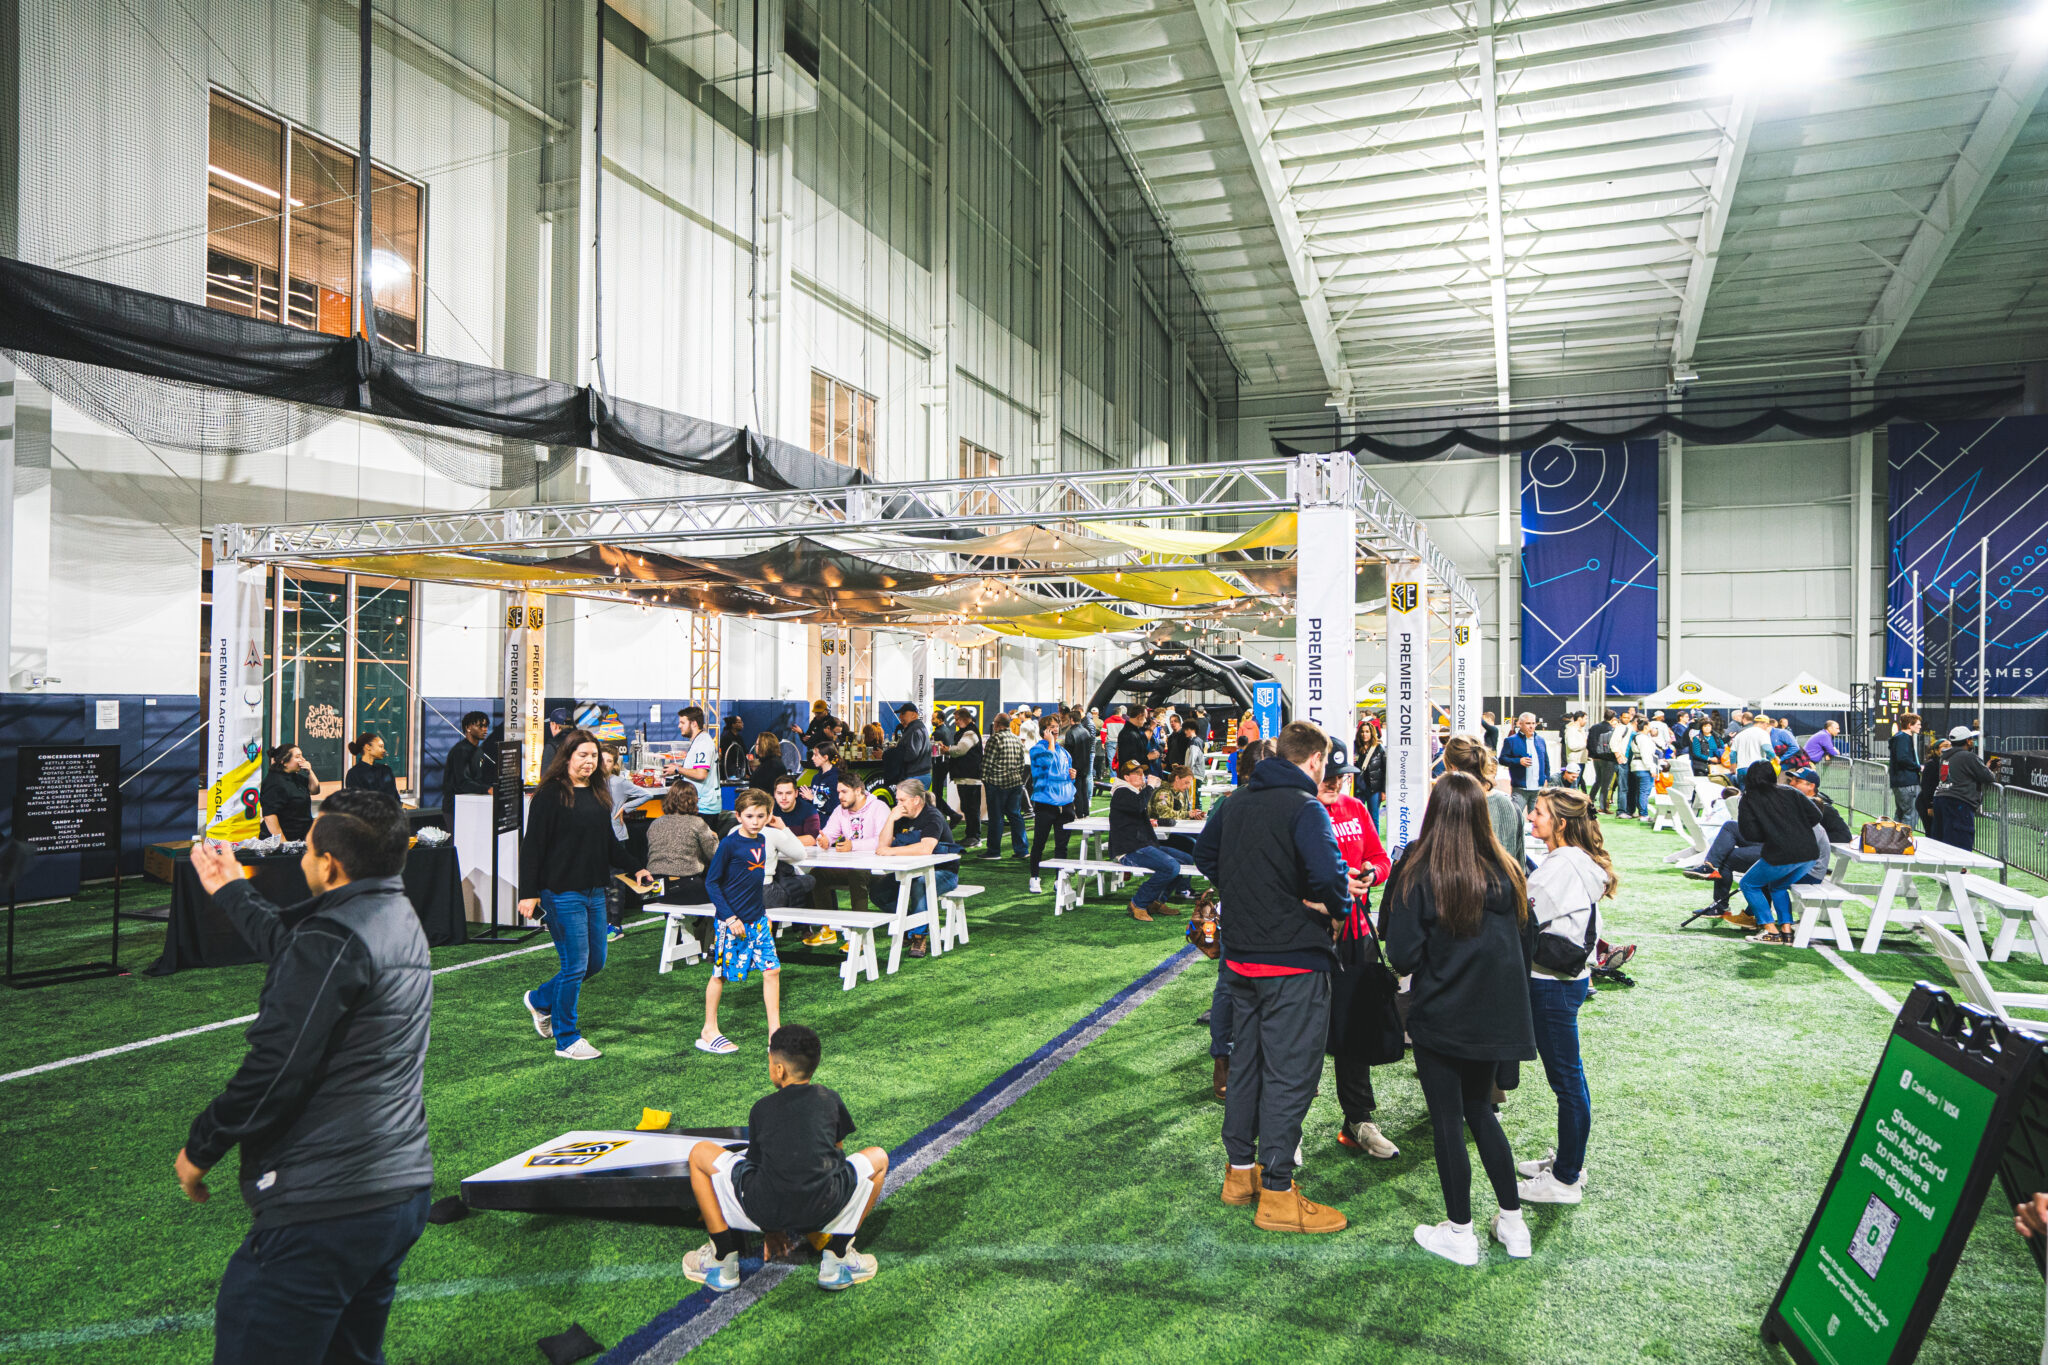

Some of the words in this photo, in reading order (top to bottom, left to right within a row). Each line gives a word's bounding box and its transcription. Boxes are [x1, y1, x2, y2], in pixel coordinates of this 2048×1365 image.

[219, 638, 227, 696] PREMIER
[510, 644, 519, 696] PREMIER
[532, 644, 540, 696] PREMIER
[1308, 618, 1322, 701] PREMIER
[1400, 633, 1411, 701] PREMIER
[1902, 668, 1937, 679] THE
[217, 699, 226, 768] LACROSSE
[510, 699, 518, 730] ZONE
[1400, 705, 1411, 746] ZONE
[694, 752, 706, 764] 12
[1399, 751, 1409, 792] Powered
[214, 771, 223, 822] LEAGUE
[1398, 792, 1408, 804] by
[1911, 1080, 1926, 1097] Cash
[1925, 1090, 1938, 1105] App
[1876, 1118, 1900, 1146] Cash
[1898, 1137, 1919, 1162] App
[1919, 1152, 1948, 1182] Card
[1891, 1108, 1918, 1137] Show
[1915, 1130, 1942, 1153] your
[1859, 1153, 1887, 1180] game
[1885, 1173, 1905, 1199] day
[1904, 1187, 1936, 1221] towel
[1876, 1141, 1888, 1158] to
[1886, 1152, 1922, 1187] receive
[1921, 1180, 1930, 1194] a
[1819, 1245, 1833, 1263] Scan
[1837, 1267, 1864, 1298] download
[1862, 1292, 1877, 1314] Cash
[1876, 1308, 1889, 1327] App
[1839, 1283, 1854, 1304] Cash
[1852, 1299, 1865, 1316] App
[1863, 1311, 1880, 1333] Card
